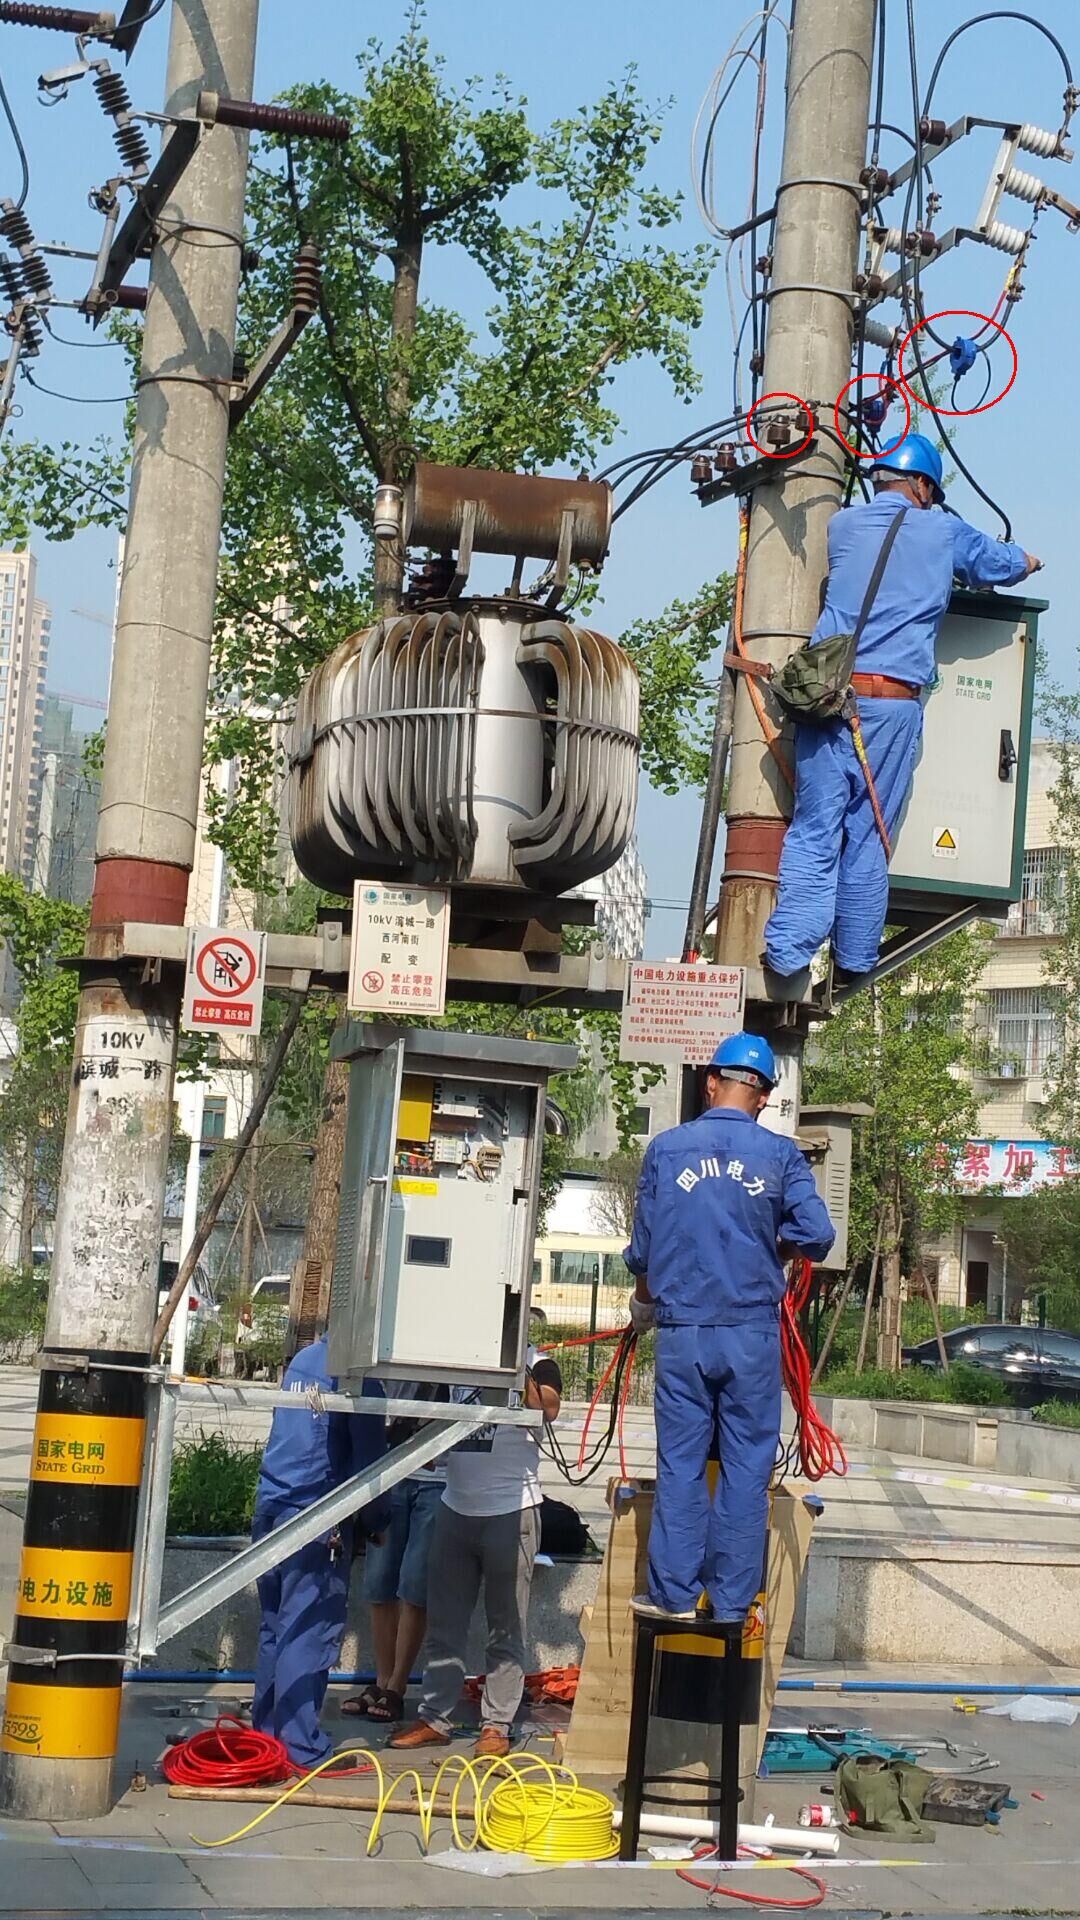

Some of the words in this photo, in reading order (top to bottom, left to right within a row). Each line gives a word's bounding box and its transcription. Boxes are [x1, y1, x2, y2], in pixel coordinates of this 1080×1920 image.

[957, 675, 992, 690] 国家电网
[955, 688, 975, 698] STATE
[976, 691, 991, 701] GRID
[382, 932, 419, 945] 西河南街
[391, 973, 433, 985] 禁止攀登
[634, 968, 738, 984] 中国电力设施重点保护
[390, 985, 433, 997] 高压危险
[101, 1032, 144, 1049] 10KV
[676, 1158, 765, 1196] 四川电力
[38, 1440, 105, 1460] 国家电网
[36, 1460, 68, 1473] STATE
[72, 1462, 105, 1475] GRID
[18, 1577, 113, 1607] 电力设施
[3, 1720, 38, 1738] 5598
